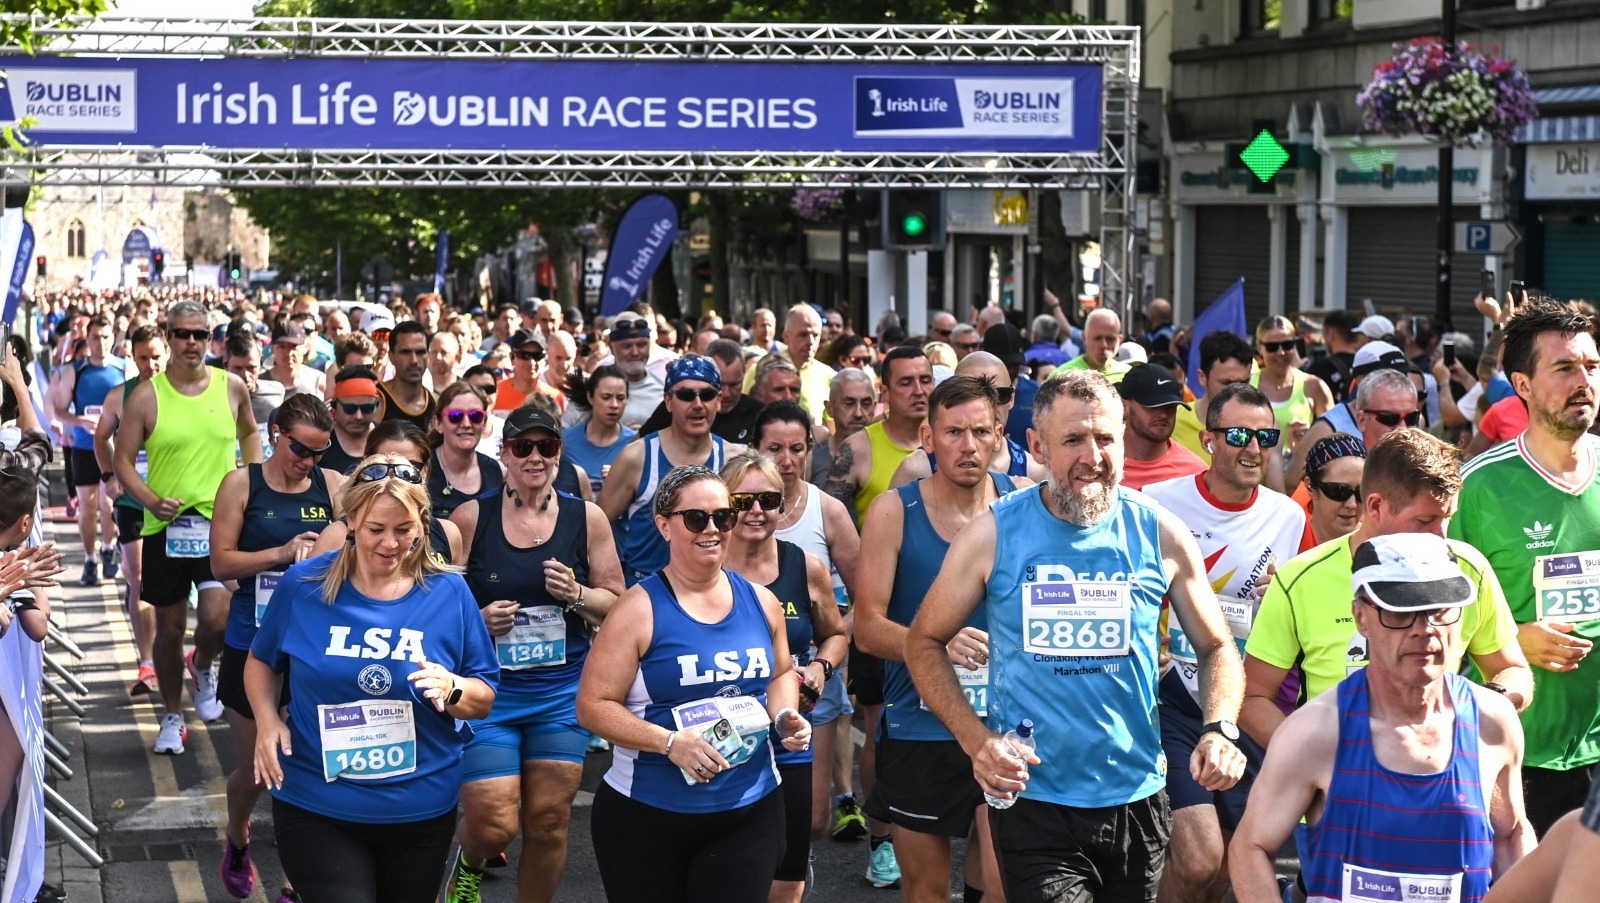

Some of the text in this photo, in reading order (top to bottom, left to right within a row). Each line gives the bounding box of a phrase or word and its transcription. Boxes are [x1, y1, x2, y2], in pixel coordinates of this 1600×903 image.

[27, 81, 121, 102] DUBLIN
[177, 81, 818, 130] Irish Life DUBLIN RACE SERIES
[887, 98, 948, 113] Irish Life
[974, 90, 1061, 110] DUBLIN
[27, 104, 121, 118] RACE SERIES
[974, 112, 1060, 124] RACE SERIES
[1556, 147, 1589, 175] Deli
[1471, 226, 1487, 249] P
[626, 218, 673, 280] Irish Life
[301, 506, 327, 519] LSA
[174, 540, 210, 553] 2330
[1525, 540, 1555, 550] adidas
[1058, 590, 1070, 598] Life
[1080, 589, 1117, 597] DUBLIN
[1030, 620, 1121, 649] 2868
[325, 625, 427, 663] LSA
[507, 643, 554, 663] 1341
[677, 647, 771, 687] LSA
[1054, 663, 1120, 676] Marathon VIII
[369, 708, 404, 717] DUBLIN
[692, 708, 715, 719] Irish Life
[336, 745, 404, 771] 1680
[1365, 882, 1395, 893] Irish Life
[1409, 884, 1452, 896] DUBLIN
